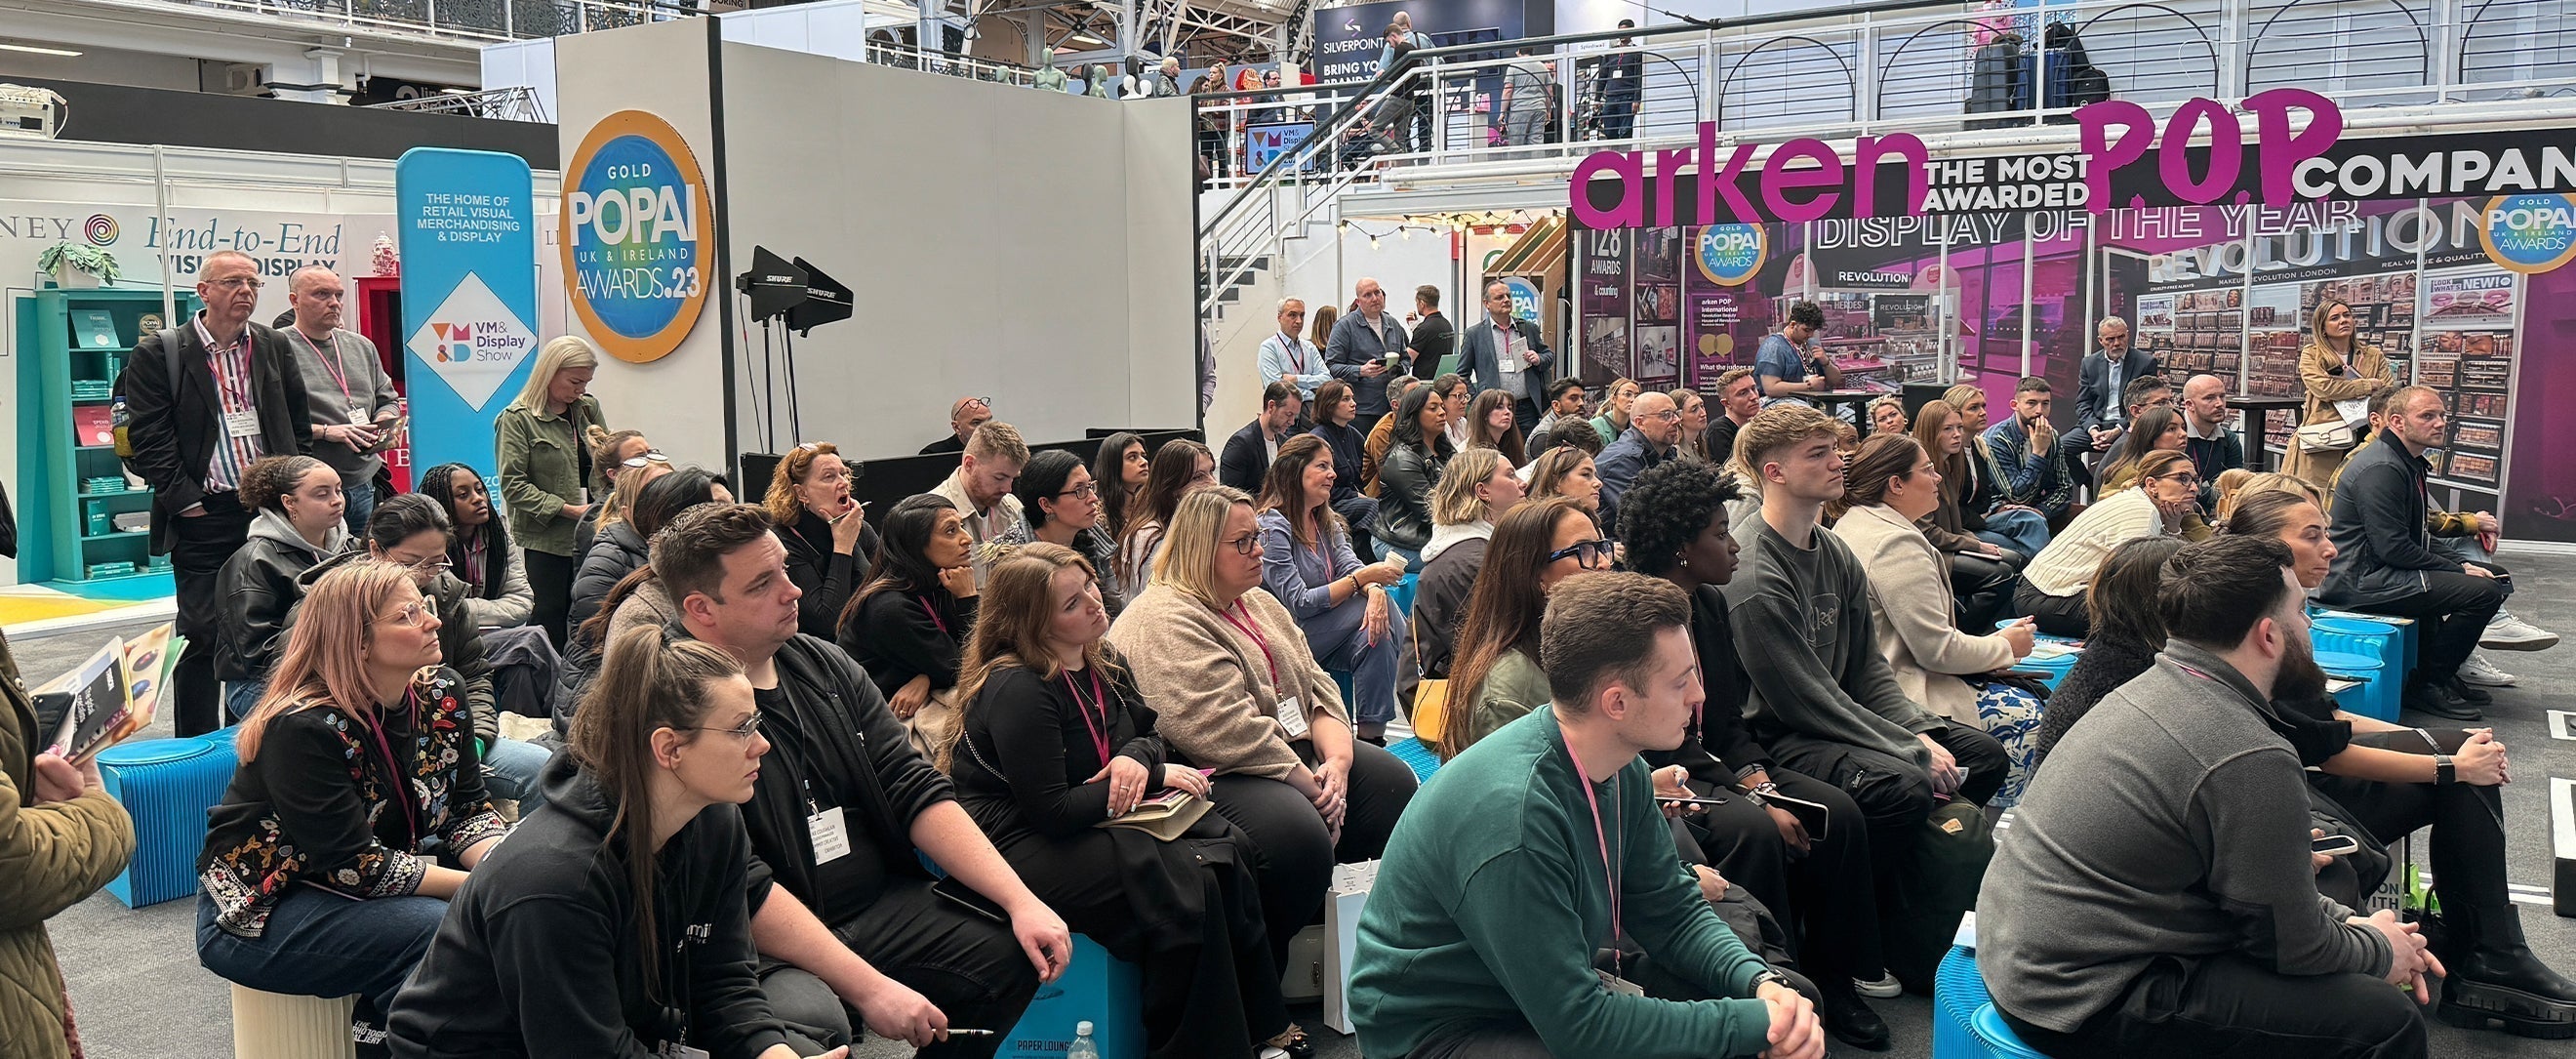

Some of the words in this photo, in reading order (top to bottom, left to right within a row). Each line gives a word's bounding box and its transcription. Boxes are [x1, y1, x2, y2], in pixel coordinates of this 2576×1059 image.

[1324, 37, 1384, 54] SILVERPOINT
[1323, 62, 1360, 76] BRING
[1362, 61, 1381, 72] YO
[1284, 137, 1304, 146] Displ
[607, 163, 652, 180] GOLD
[1569, 121, 1928, 229] arken
[1923, 159, 1986, 185] THE
[1998, 154, 2093, 183] MOST
[2292, 146, 2576, 195] COMPAN
[425, 193, 451, 204] THE
[454, 194, 491, 206] HOME
[494, 196, 510, 207] OF
[1920, 183, 2090, 212] AWARDED
[423, 206, 467, 217] RETAIL
[469, 207, 514, 219] VISUAL
[568, 183, 698, 247] POPAI
[417, 219, 520, 231] MERCHANDISING
[1817, 211, 2010, 250] DISPLAY
[2032, 209, 2089, 243] OF
[2105, 206, 2202, 240] THE
[2219, 200, 2360, 237] YEAR
[144, 216, 342, 256] End-to-End
[437, 231, 447, 242] &
[450, 232, 502, 243] DISPLAY
[1701, 232, 1761, 252] POPAI
[2149, 199, 2481, 283] REVOLUTION
[2499, 237, 2566, 250] AWARDS
[580, 251, 597, 263] UK
[606, 250, 614, 262] &
[623, 247, 688, 261] IRELAND
[1709, 256, 1752, 267] AWARDS
[2382, 260, 2402, 268] REAL
[2404, 258, 2434, 266] VAUE
[2444, 252, 2486, 263] QUALITY
[1590, 260, 1621, 275] AWARDS
[766, 274, 793, 283] SHURE
[1838, 270, 1909, 283] REVOLUTION
[2251, 271, 2297, 283] EVOLUTION
[2300, 267, 2337, 278] LONDON
[2463, 277, 2499, 290] NEW!
[806, 287, 836, 299] SHURE
[1598, 284, 1619, 299] counting
[1512, 296, 1539, 312] PAI
[476, 335, 526, 348] Display
[476, 349, 512, 361] Show
[2372, 896, 2398, 910] ITH
[352, 1025, 388, 1039] PHOTOGRA
[354, 1020, 372, 1030] THE
[1018, 1039, 1042, 1051] PAPER
